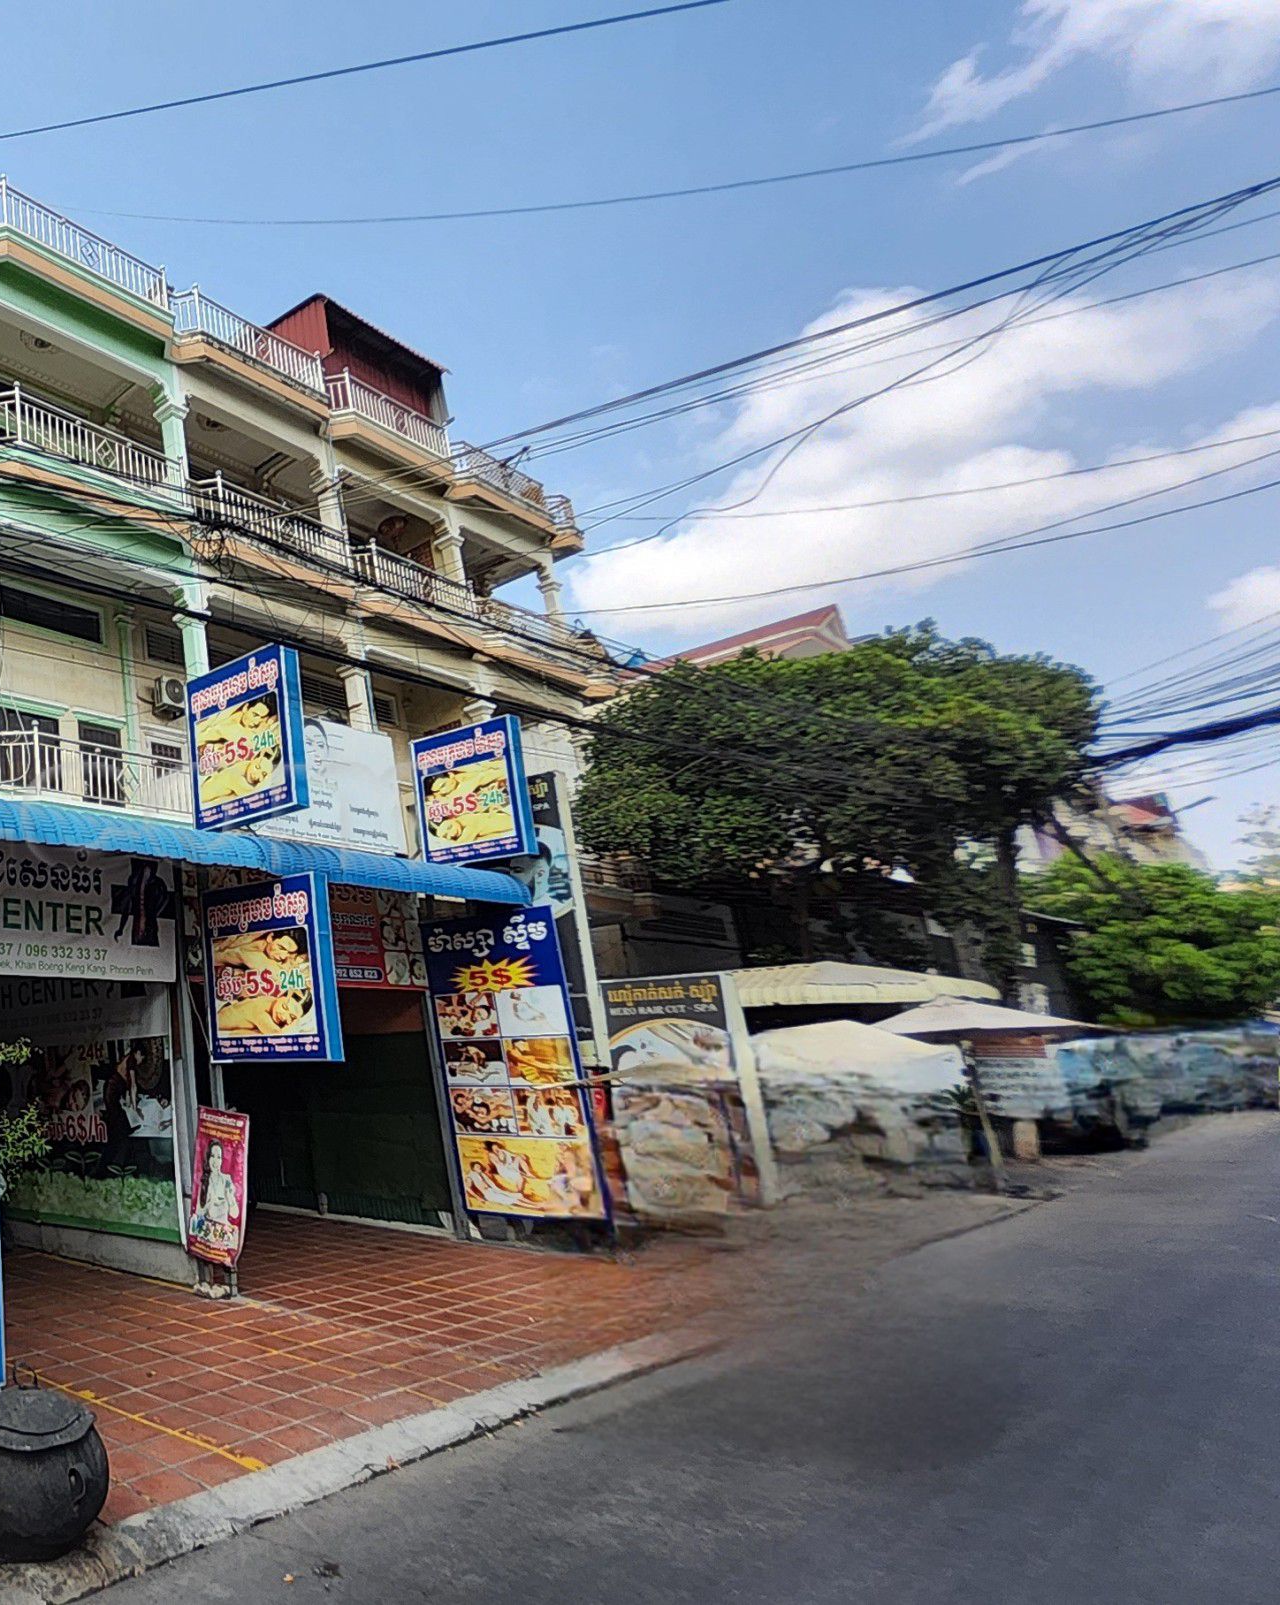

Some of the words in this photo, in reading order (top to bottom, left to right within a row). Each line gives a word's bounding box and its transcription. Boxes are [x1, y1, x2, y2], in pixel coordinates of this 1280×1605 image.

[253, 730, 275, 751] 24h
[480, 791, 504, 807] 24h
[428, 927, 495, 957] ម៉ាស្សា
[17, 943, 22, 956] /
[25, 943, 48, 957] 096
[51, 945, 73, 959] 332
[76, 947, 91, 960] 33
[94, 949, 108, 961] 37
[15, 960, 36, 971] Khan
[38, 961, 63, 973] Boeng
[65, 962, 85, 974] Keng
[336, 968, 349, 977] 92
[468, 967, 513, 986] 5$
[246, 968, 275, 997] 5$
[280, 969, 306, 990] 24h
[18, 979, 98, 1006] CENTER
[665, 1004, 686, 1014] CUT
[693, 1003, 718, 1013] SPA
